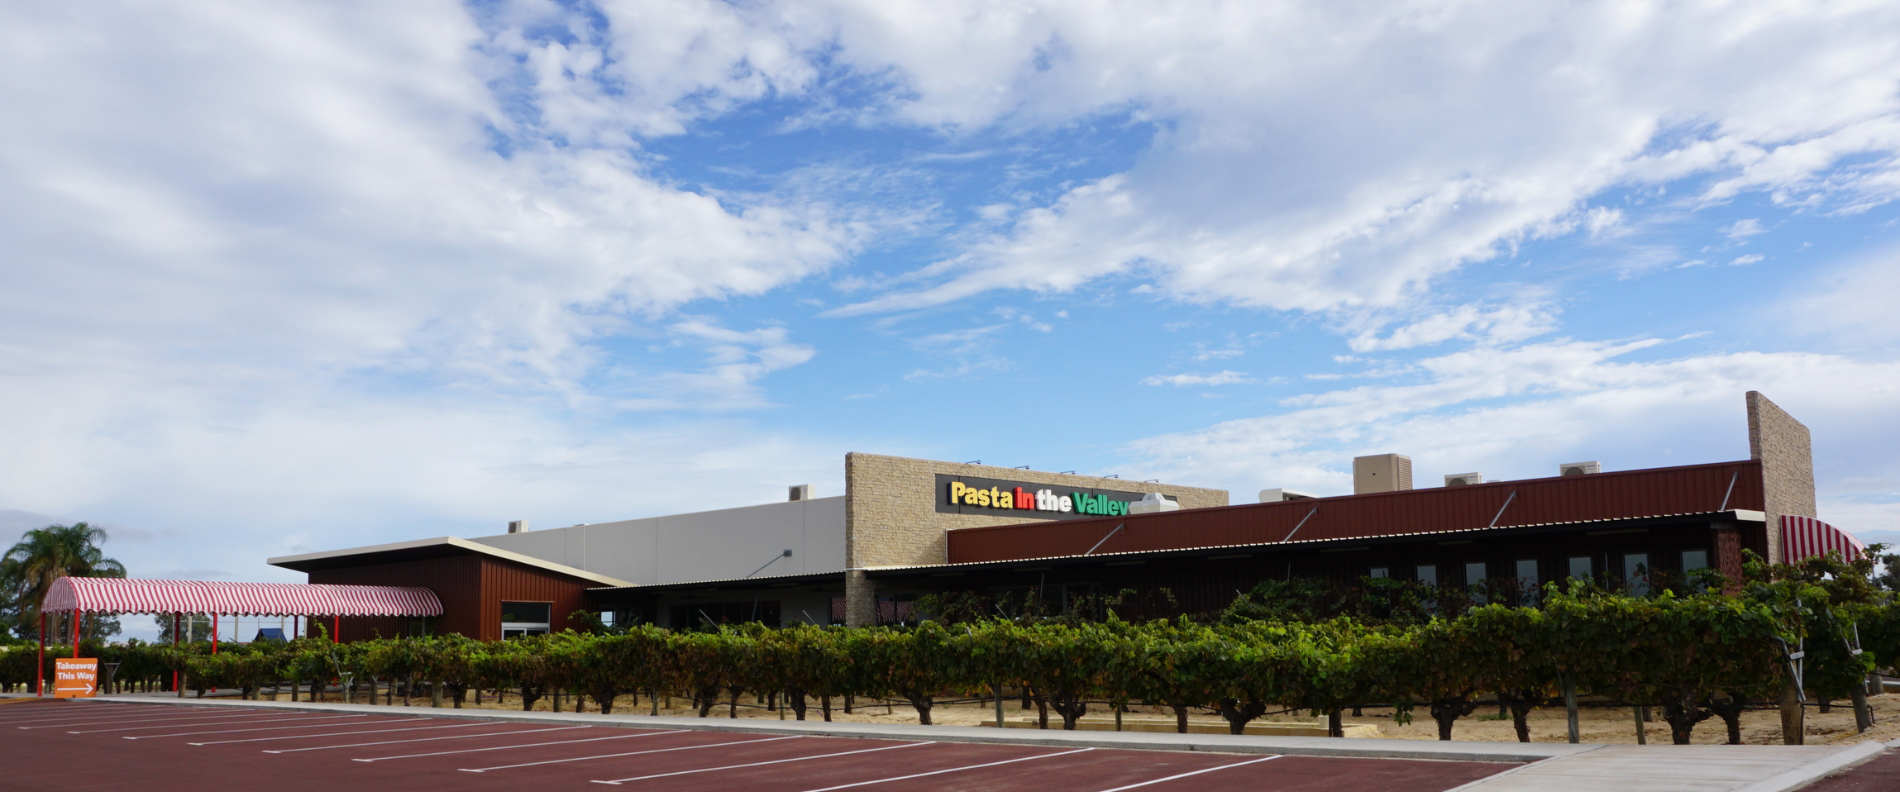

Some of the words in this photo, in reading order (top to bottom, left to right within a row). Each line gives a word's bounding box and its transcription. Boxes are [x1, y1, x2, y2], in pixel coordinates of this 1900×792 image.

[950, 481, 1013, 508] Pasta
[1014, 487, 1035, 509] in
[1035, 489, 1072, 512] the
[56, 662, 97, 671] Takeaway
[57, 672, 75, 680] This
[76, 672, 95, 681] Way
